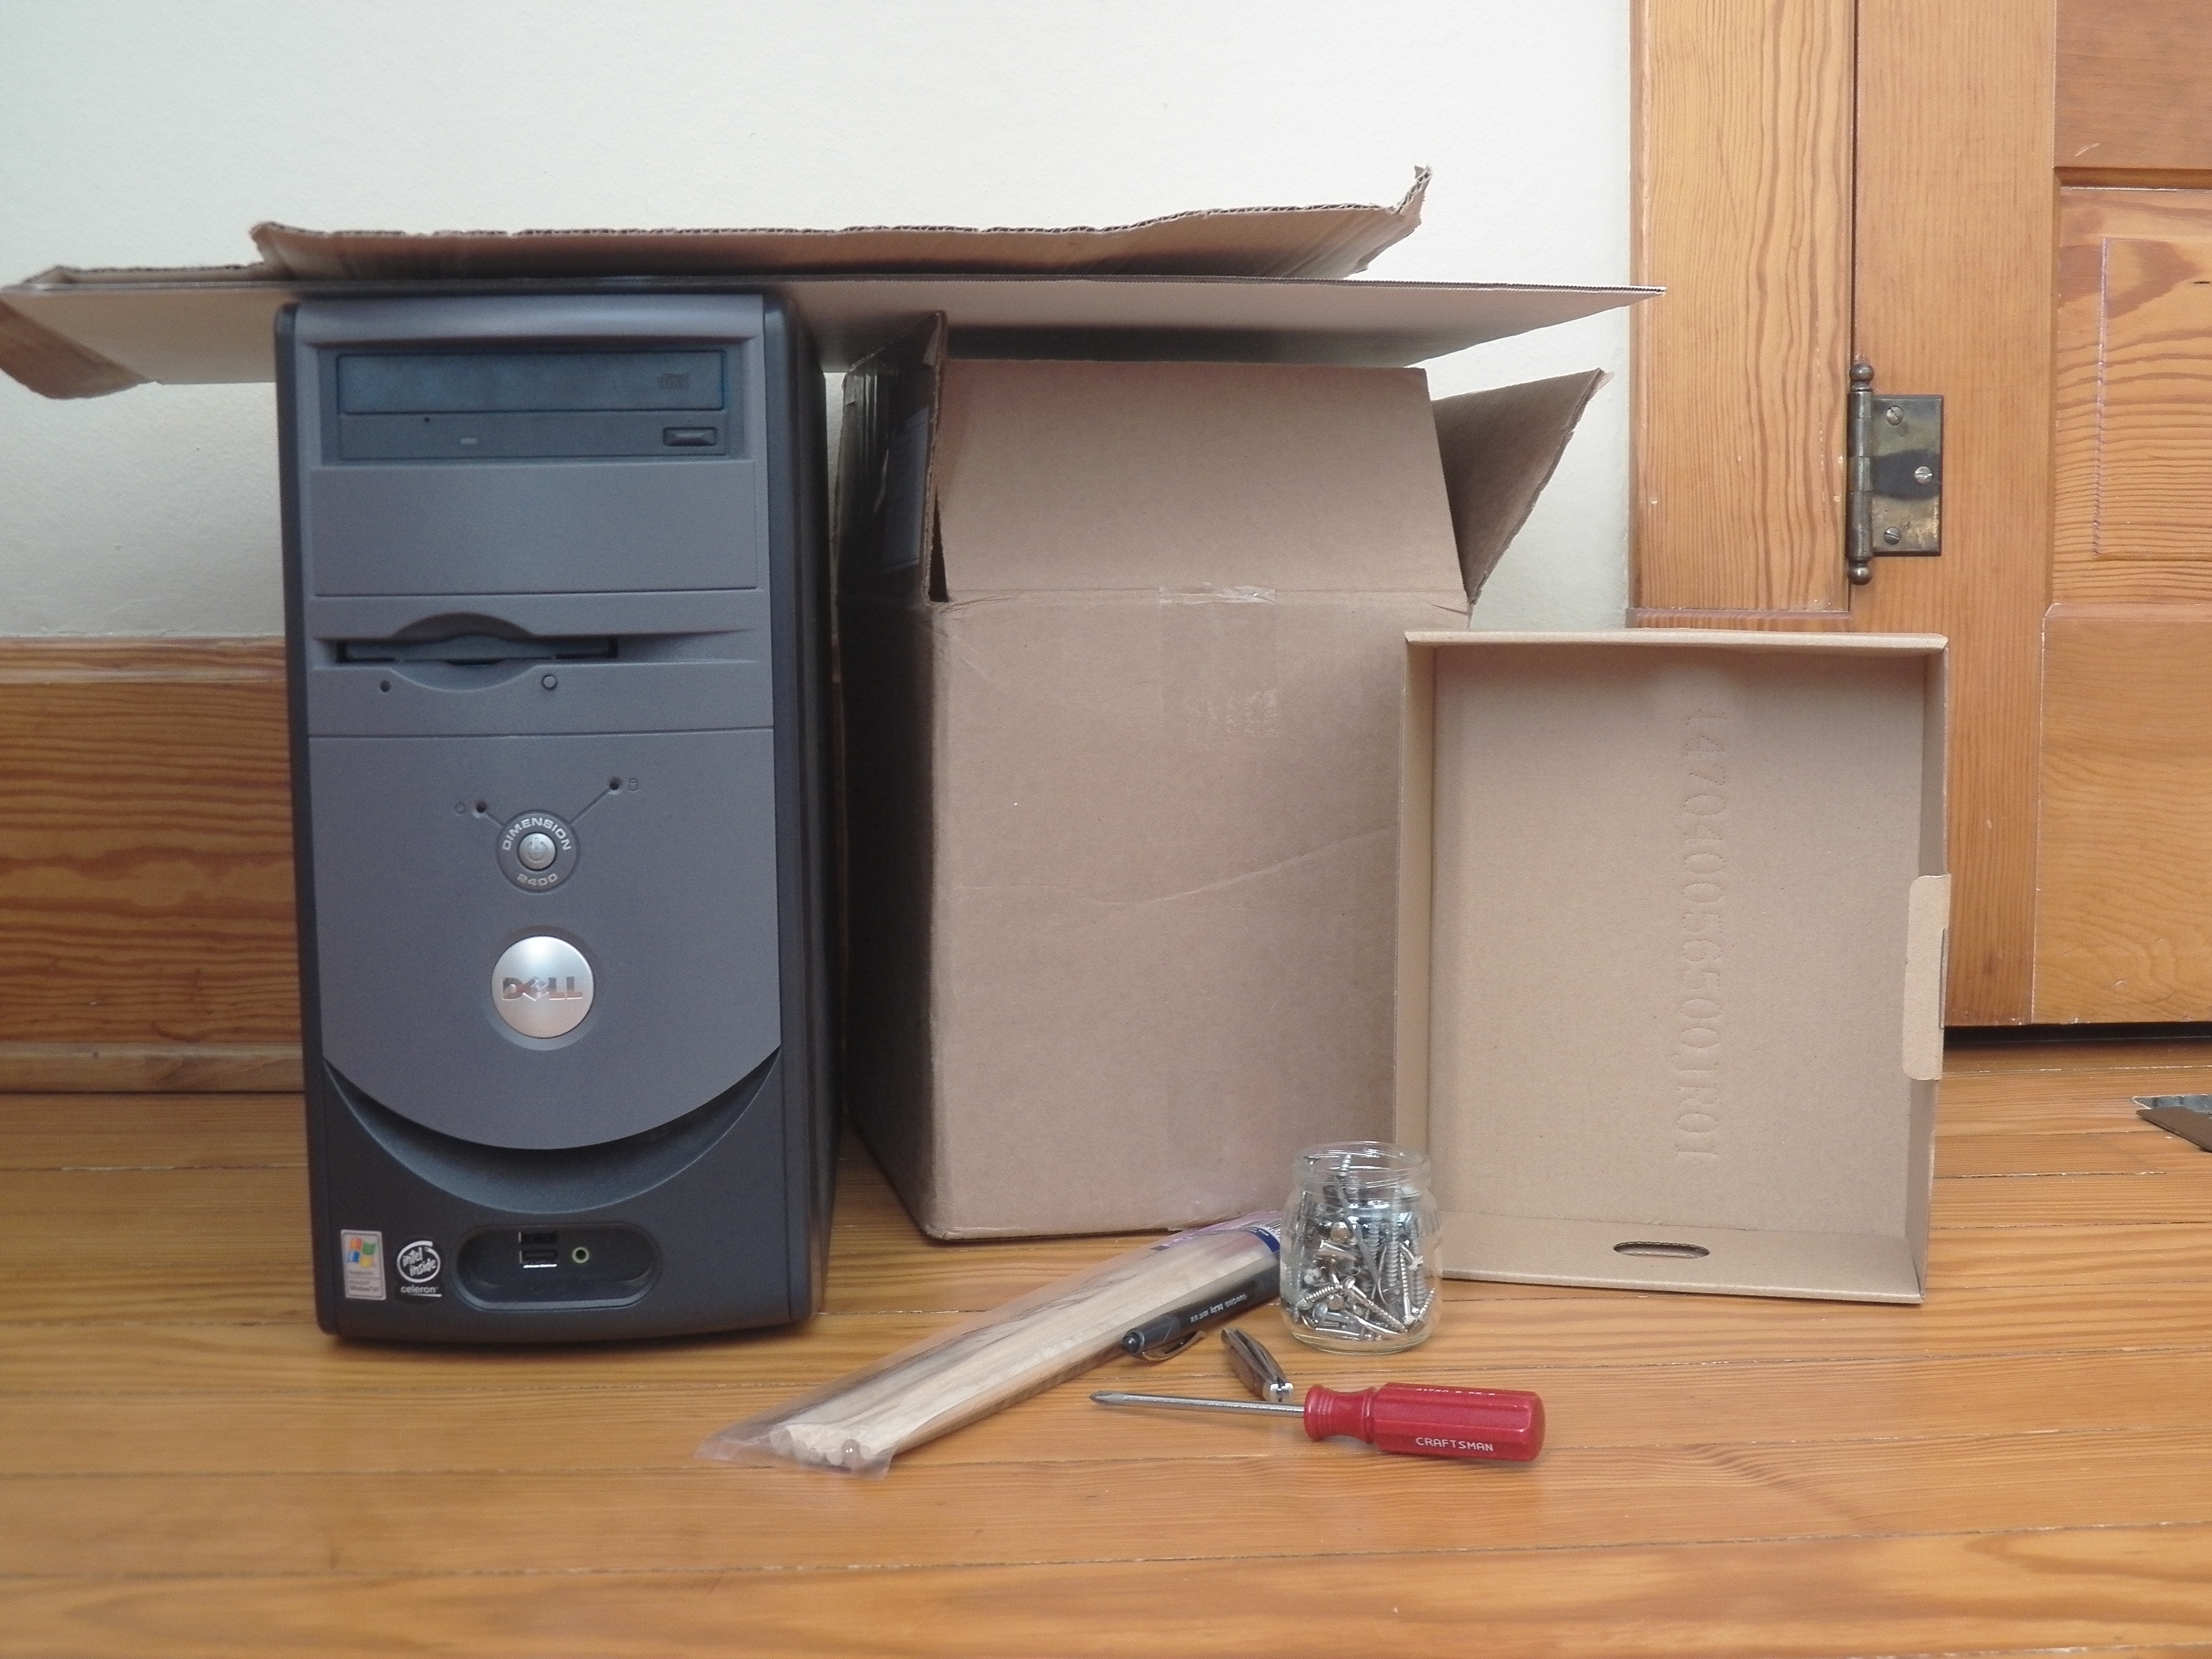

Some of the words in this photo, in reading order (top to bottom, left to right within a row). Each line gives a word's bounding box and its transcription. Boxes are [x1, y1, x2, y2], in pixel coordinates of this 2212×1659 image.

[502, 817, 571, 851] DIMENSION
[517, 873, 559, 886] 2400
[503, 976, 583, 1000] DELL
[402, 1246, 423, 1267] intel
[410, 1258, 437, 1277] inside
[1415, 1437, 1494, 1452] CRAFTSMAN
